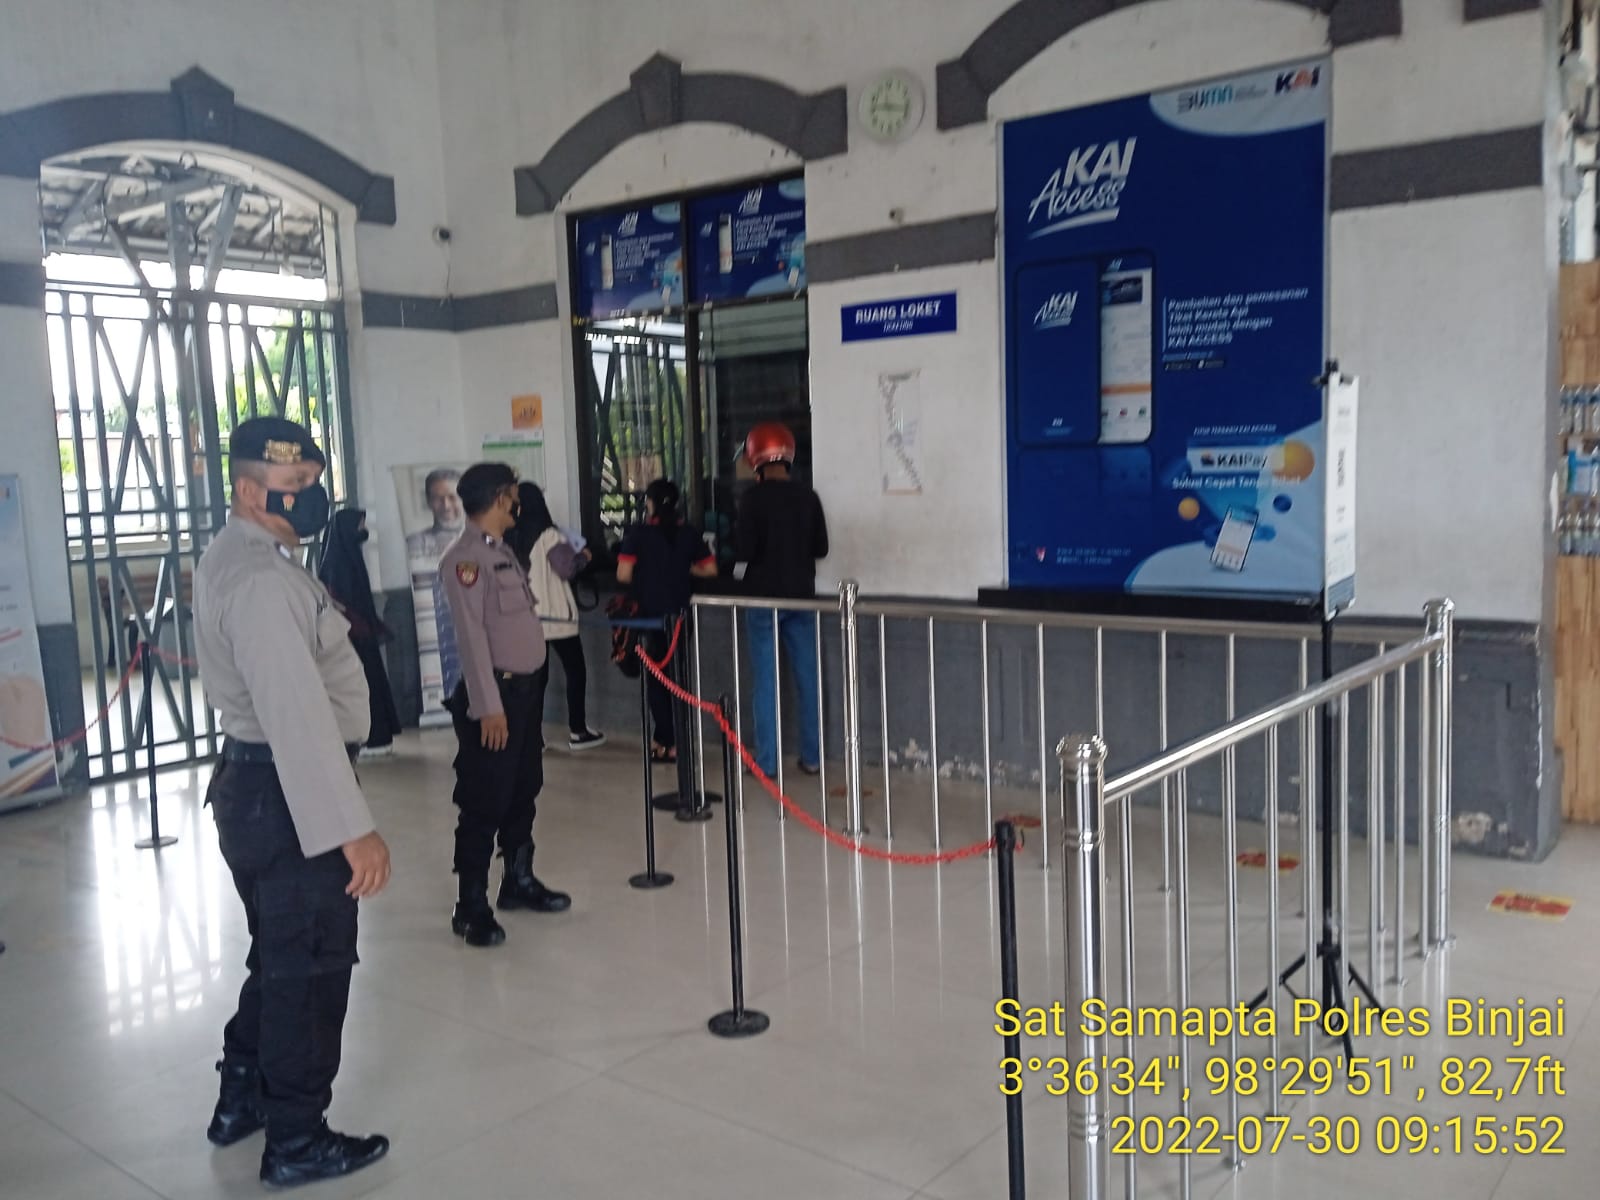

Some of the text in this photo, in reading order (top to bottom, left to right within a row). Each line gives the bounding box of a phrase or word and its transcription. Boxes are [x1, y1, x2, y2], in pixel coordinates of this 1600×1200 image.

[1275, 65, 1321, 95] KAI
[1063, 136, 1138, 188] KAI
[1027, 168, 1126, 224] Access
[855, 300, 942, 324] RUANG LOKET
